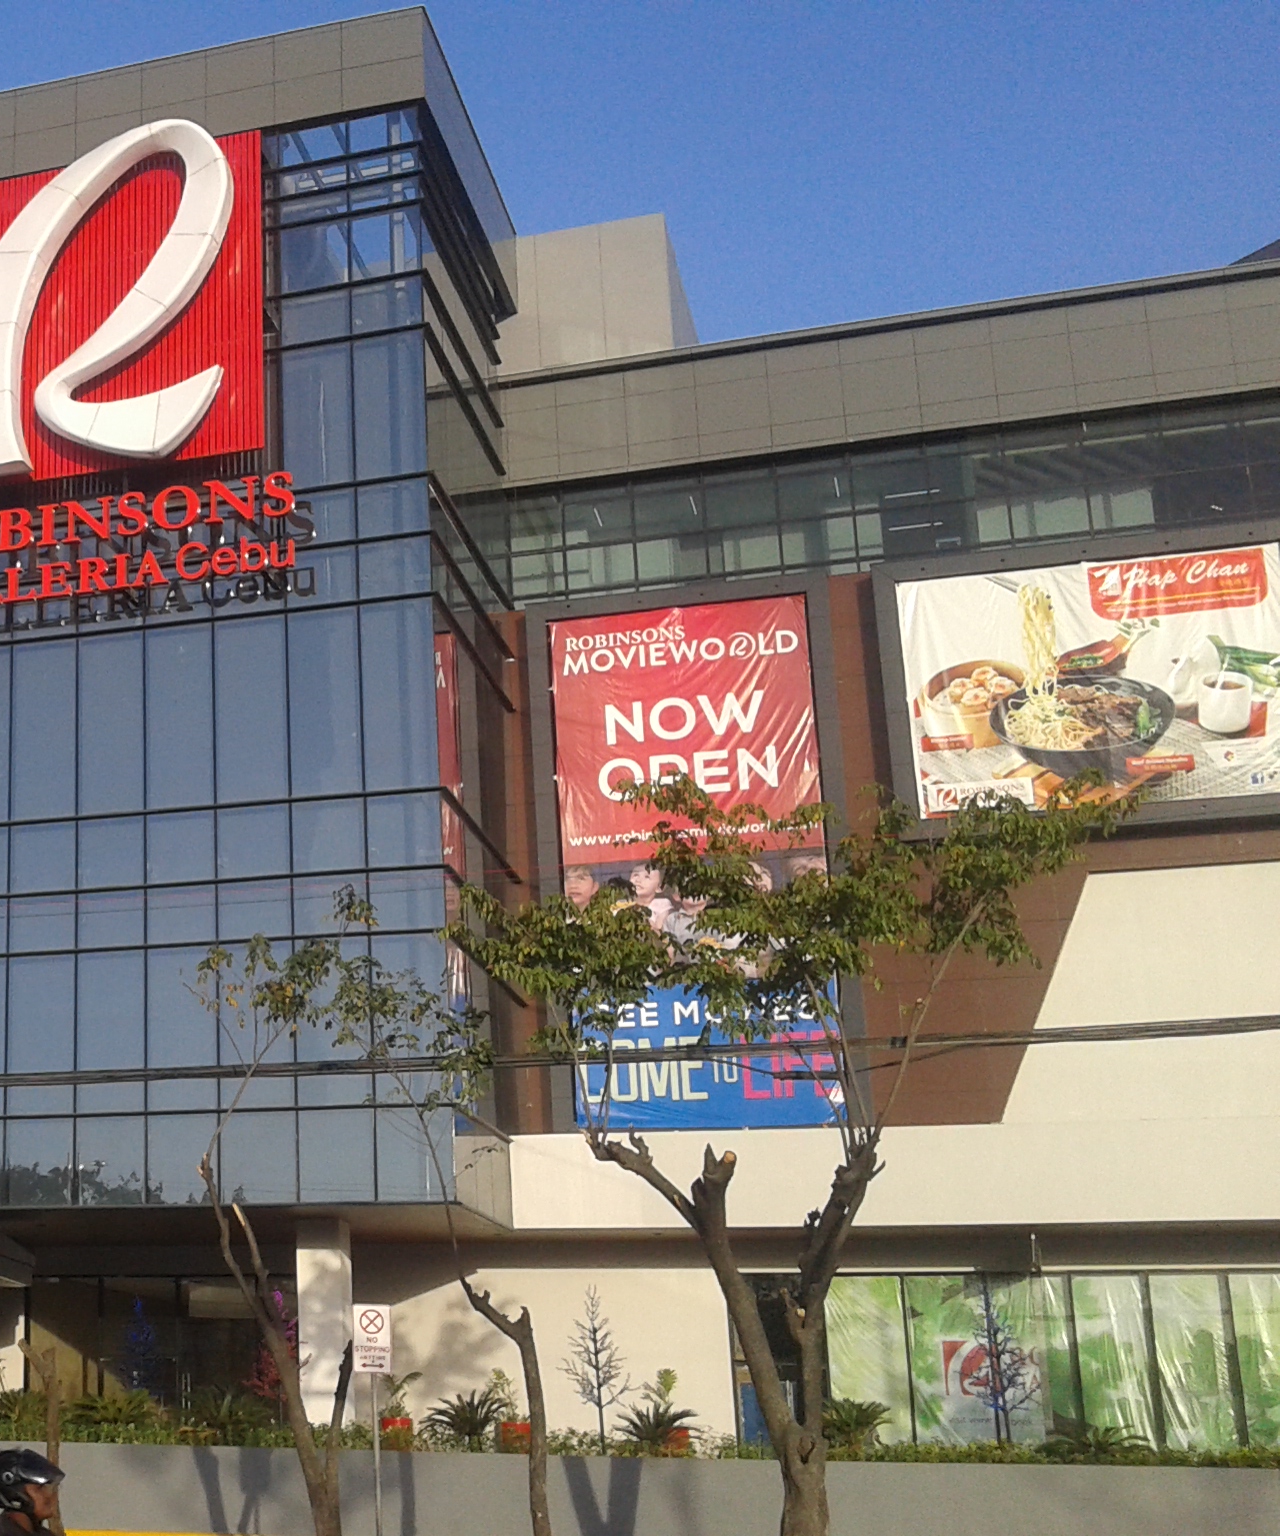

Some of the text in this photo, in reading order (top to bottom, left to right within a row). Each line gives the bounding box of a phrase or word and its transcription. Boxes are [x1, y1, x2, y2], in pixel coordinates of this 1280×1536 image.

[175, 537, 297, 580] Cebu
[1186, 559, 1250, 584] Chan
[565, 625, 686, 652] ROBINSONS
[604, 690, 764, 746] NOW
[598, 745, 779, 802] OPEN
[595, 1001, 659, 1028] EE
[739, 1029, 839, 1100] LIFE
[355, 1345, 390, 1353] STOPPING
